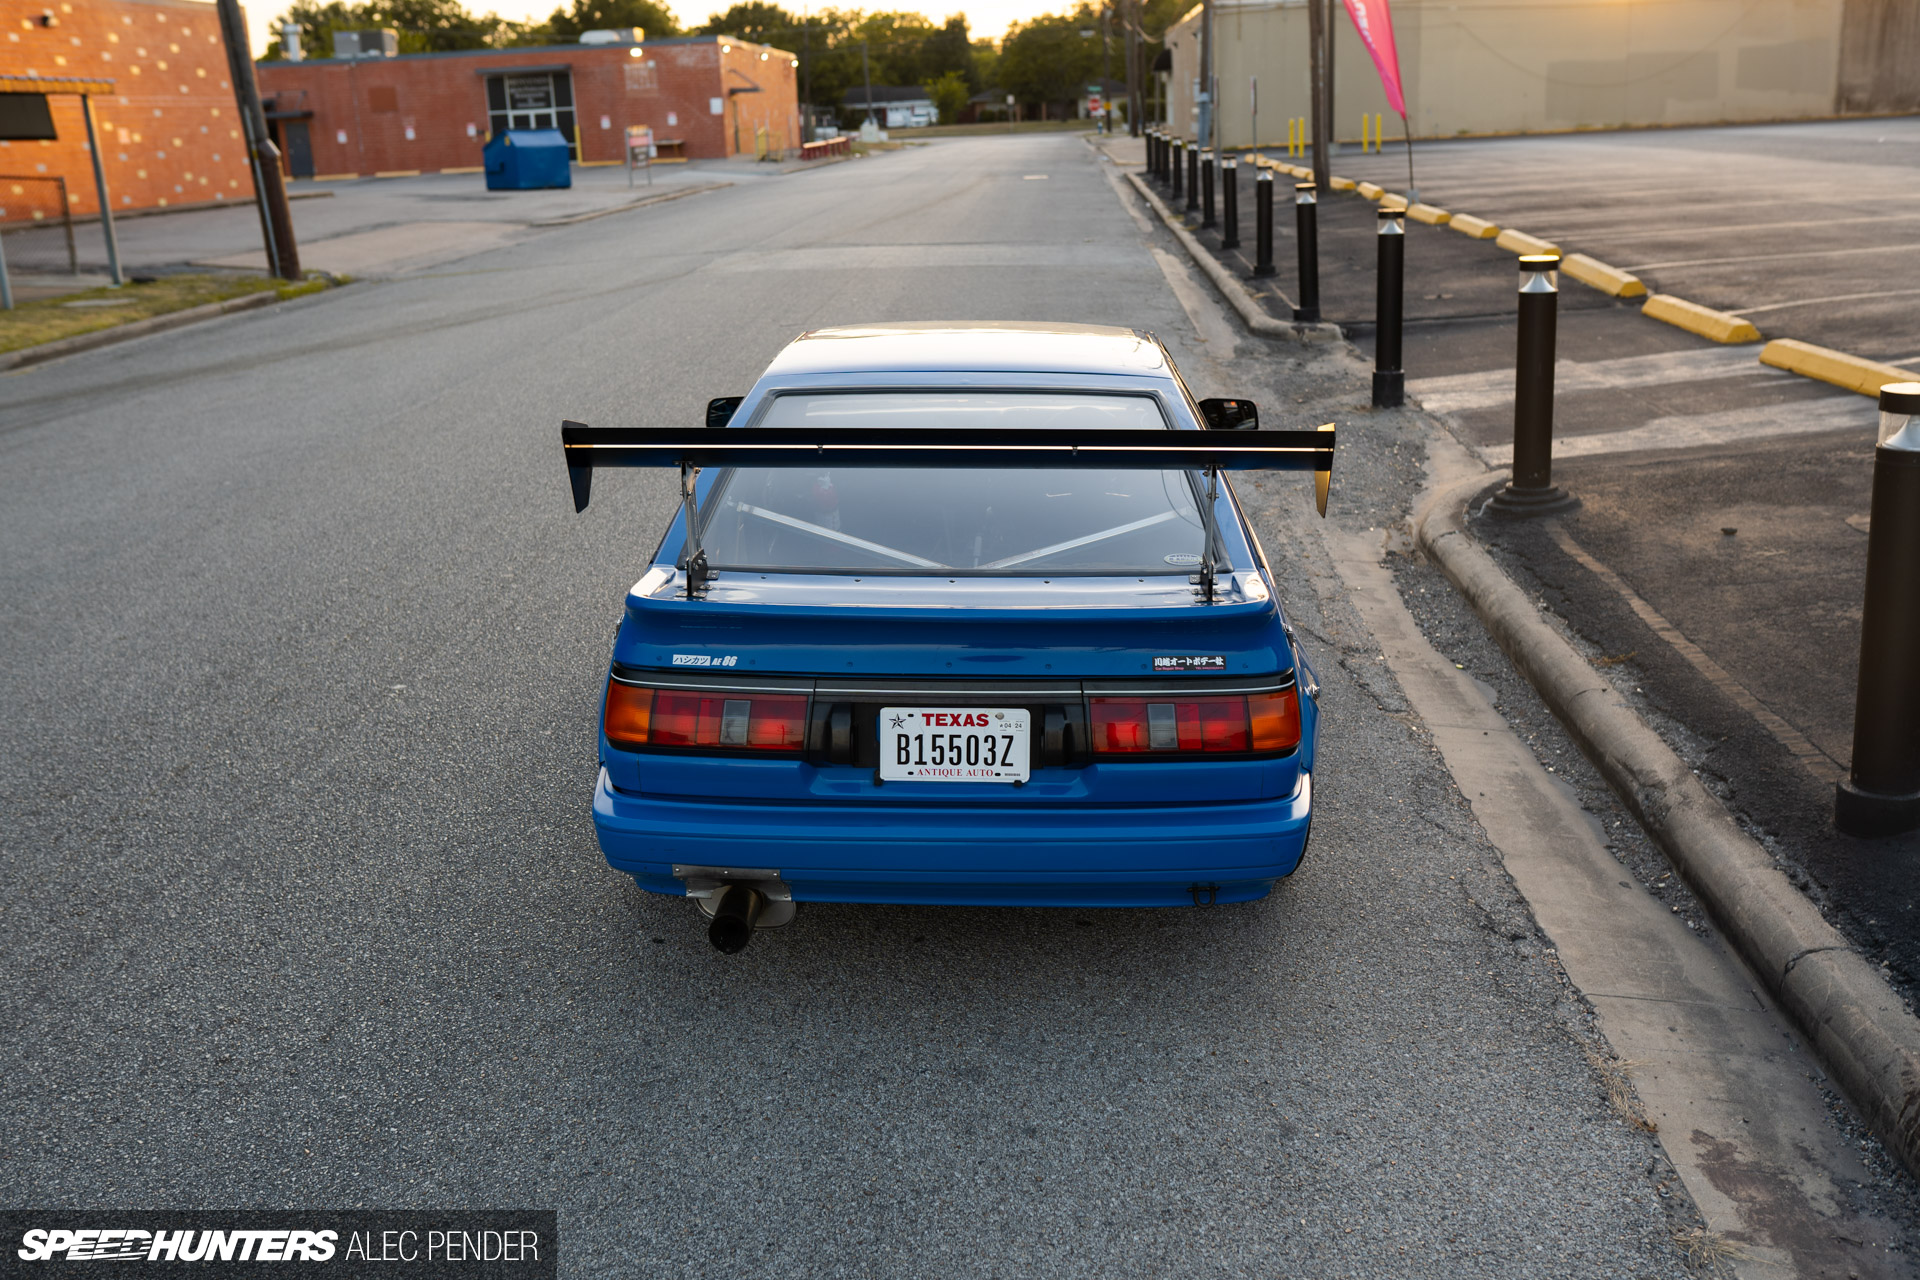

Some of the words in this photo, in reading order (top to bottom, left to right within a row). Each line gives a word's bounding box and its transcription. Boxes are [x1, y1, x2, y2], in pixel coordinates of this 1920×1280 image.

[922, 713, 989, 727] TEXAS
[897, 733, 1014, 767] B15503Z
[917, 768, 962, 777] ANTIQUE
[966, 769, 993, 777] AUTO
